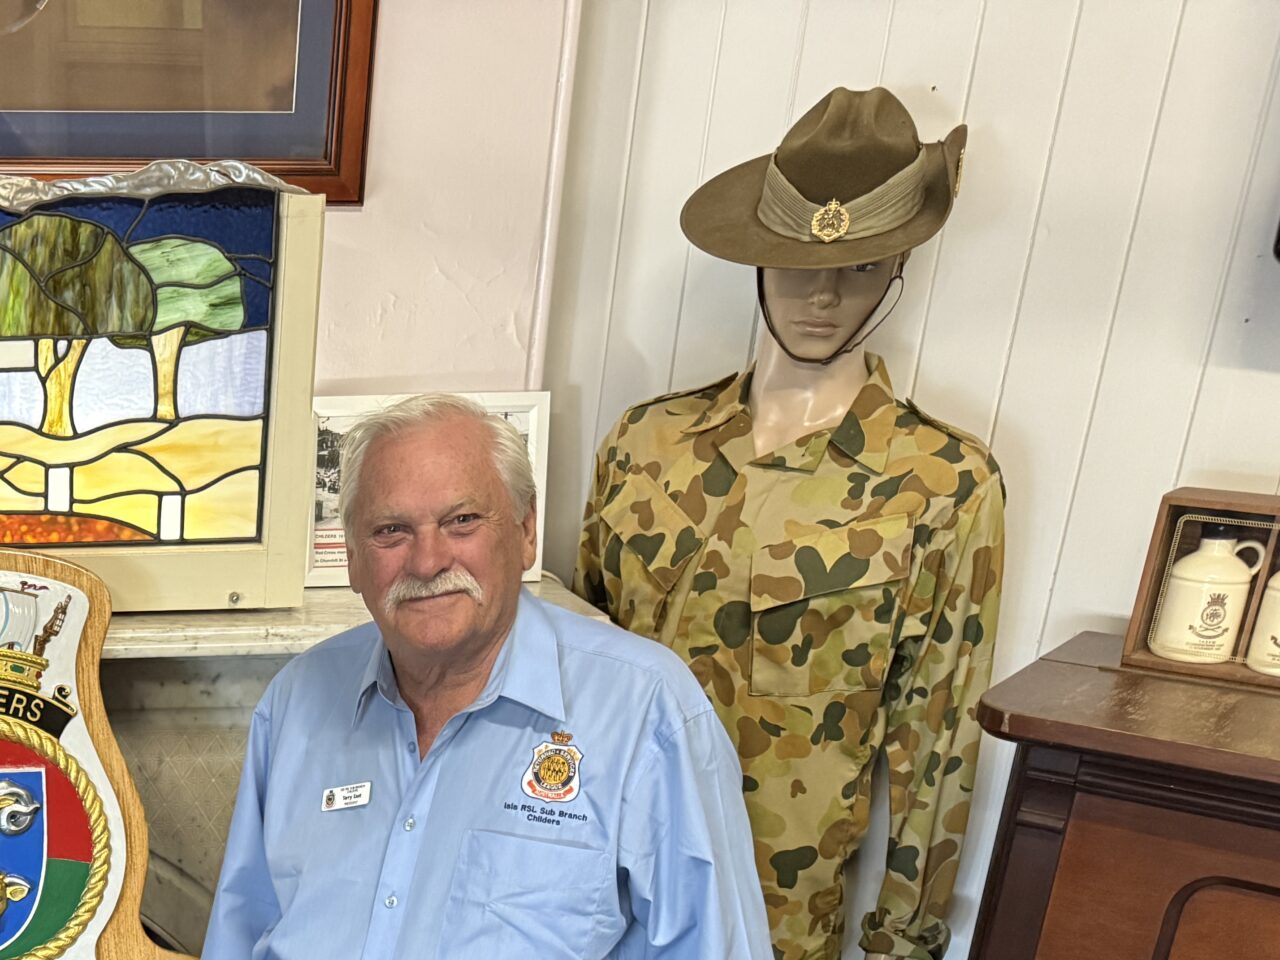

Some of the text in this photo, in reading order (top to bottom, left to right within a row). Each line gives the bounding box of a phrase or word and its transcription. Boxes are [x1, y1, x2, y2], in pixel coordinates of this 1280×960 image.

[520, 804, 537, 813] RSL
[539, 807, 556, 816] Sub
[558, 810, 588, 822] Branch
[526, 813, 561, 826] Childers
